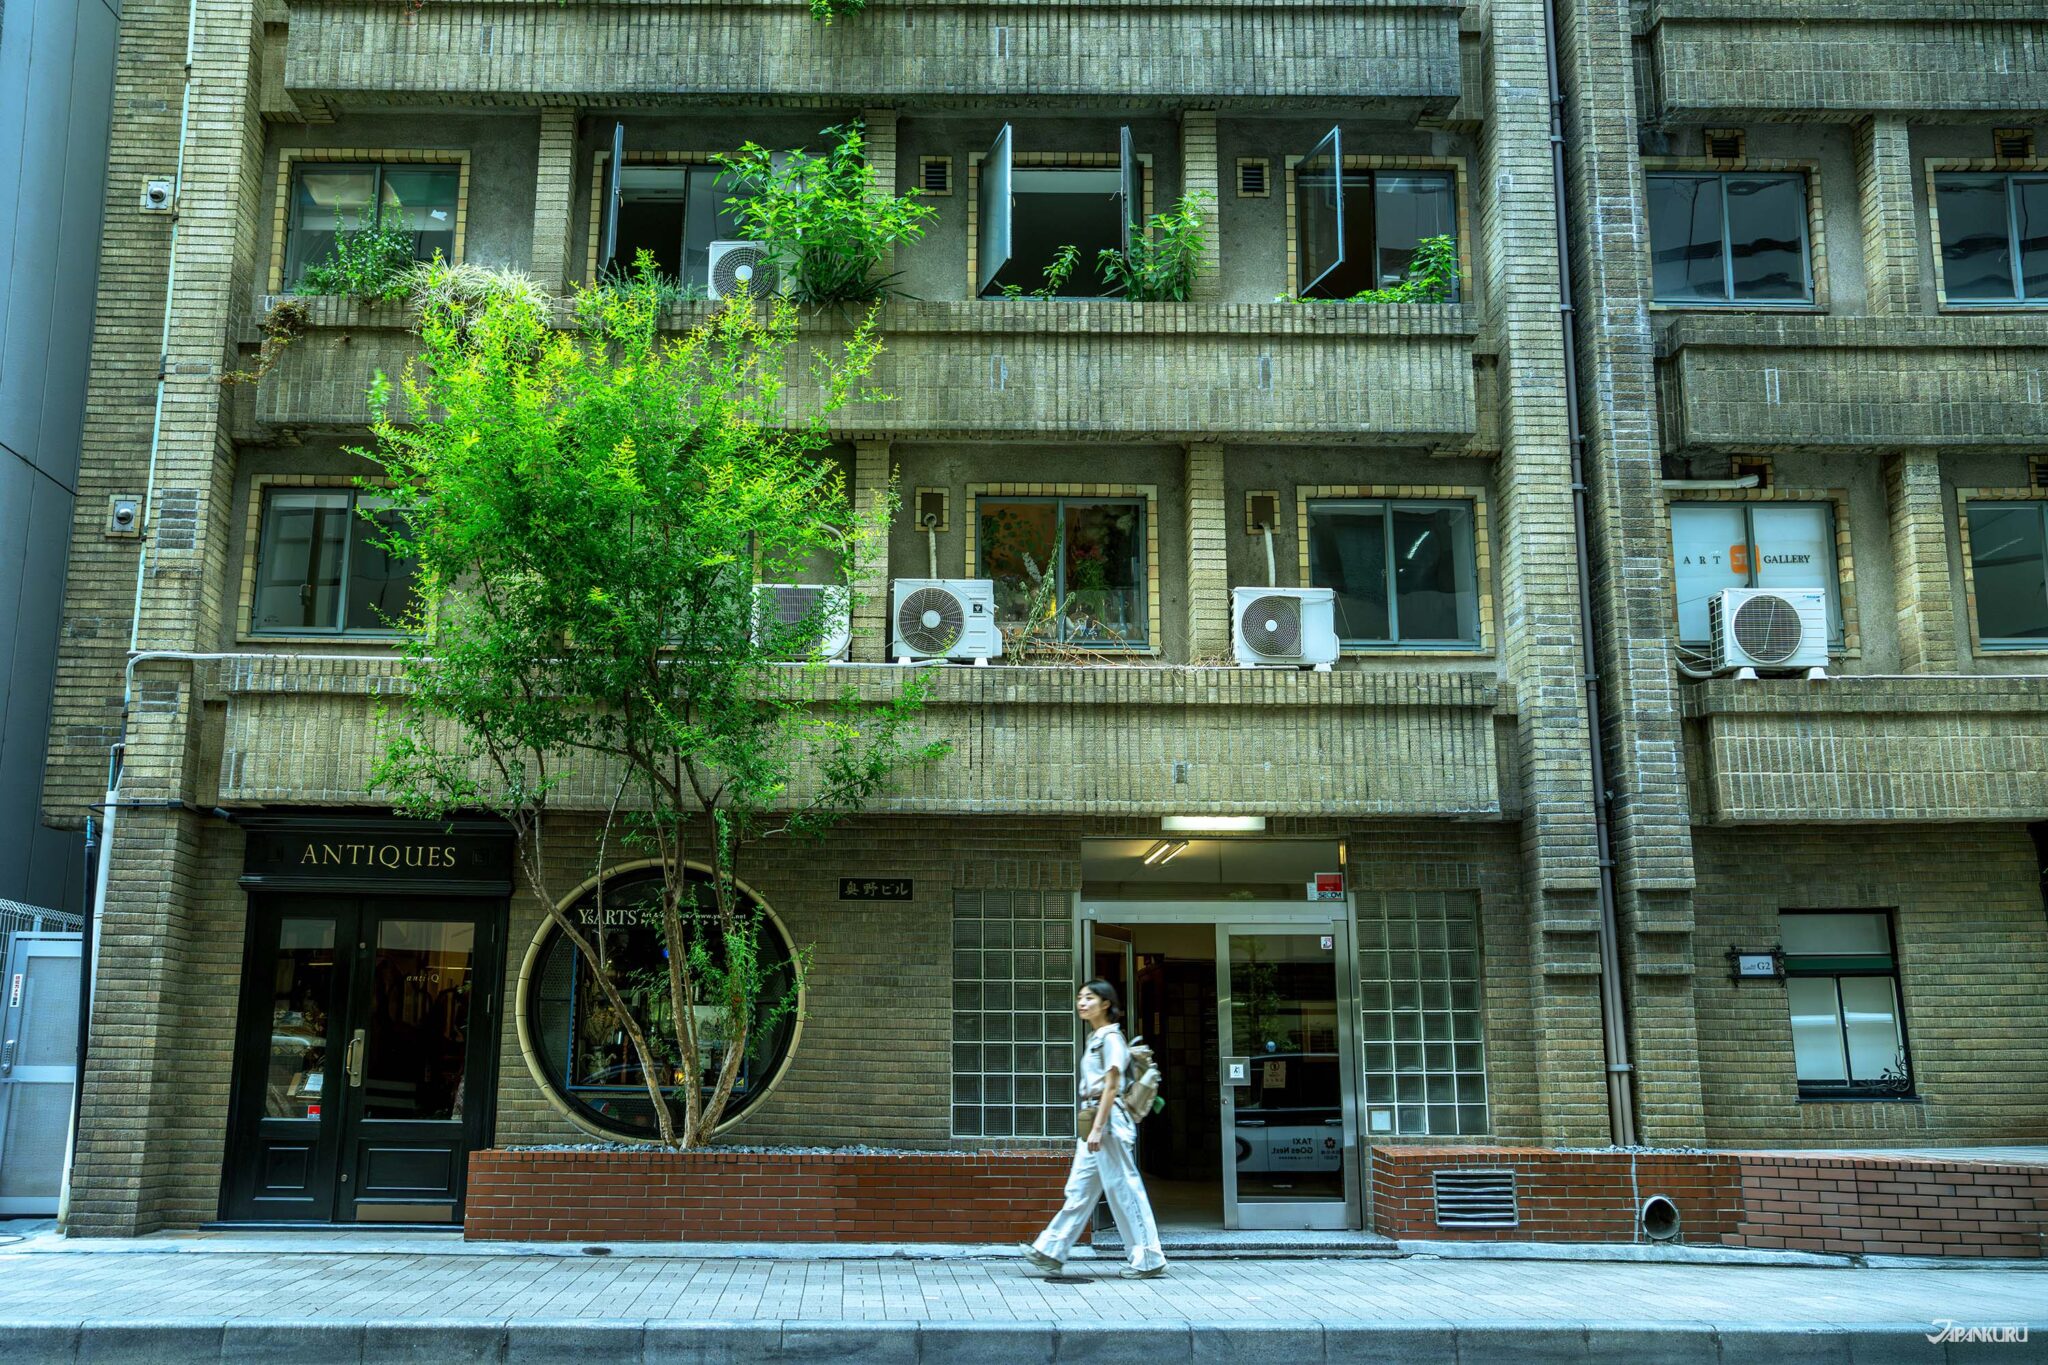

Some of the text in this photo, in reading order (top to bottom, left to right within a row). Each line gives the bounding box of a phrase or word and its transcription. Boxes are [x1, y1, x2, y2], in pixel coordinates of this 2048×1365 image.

[1683, 555, 1810, 564] ART GALLERY
[300, 844, 456, 868] ANTIQUES
[845, 881, 908, 896] 奥野ビル
[1757, 962, 1770, 970] G2
